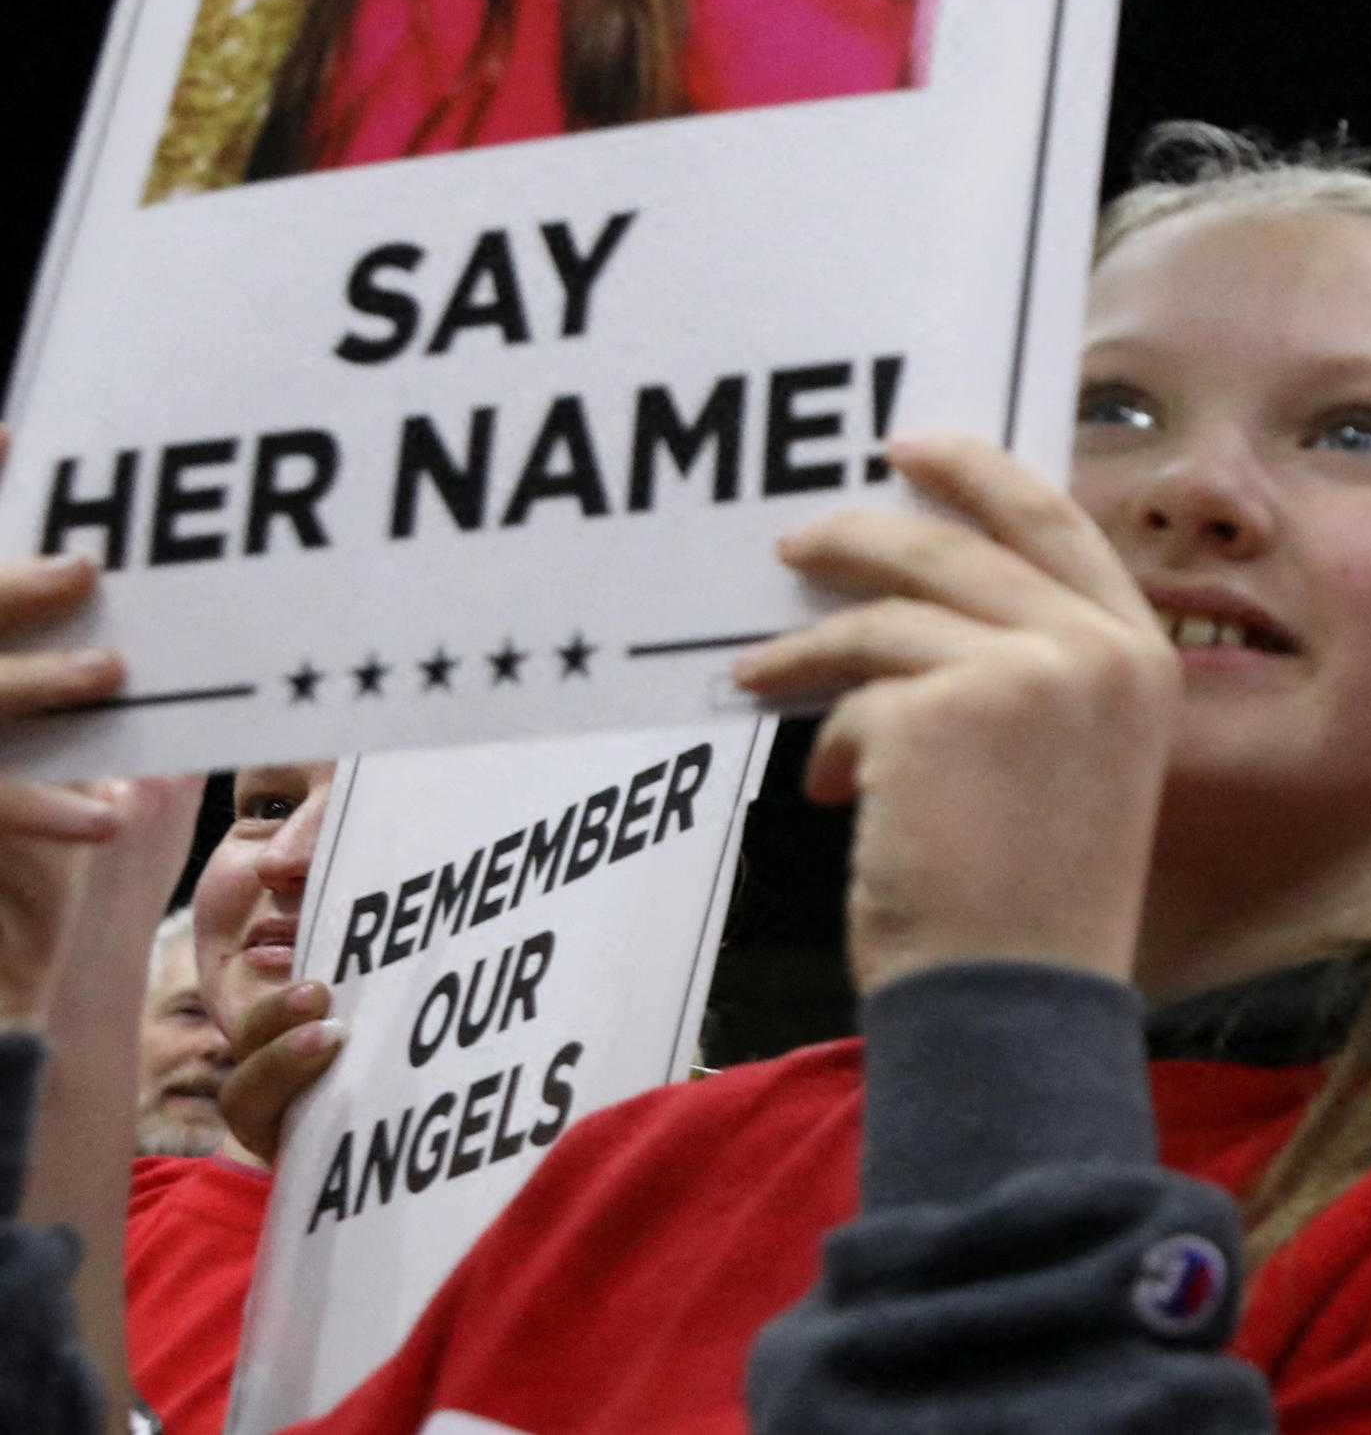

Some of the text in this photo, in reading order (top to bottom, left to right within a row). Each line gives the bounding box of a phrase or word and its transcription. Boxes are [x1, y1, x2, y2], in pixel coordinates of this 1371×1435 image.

[333, 211, 636, 367] SAY
[38, 355, 905, 574] HER NAME!
[333, 742, 713, 986] REMEMBER
[408, 930, 556, 1069] OUR
[305, 1041, 584, 1236] ANGELS
